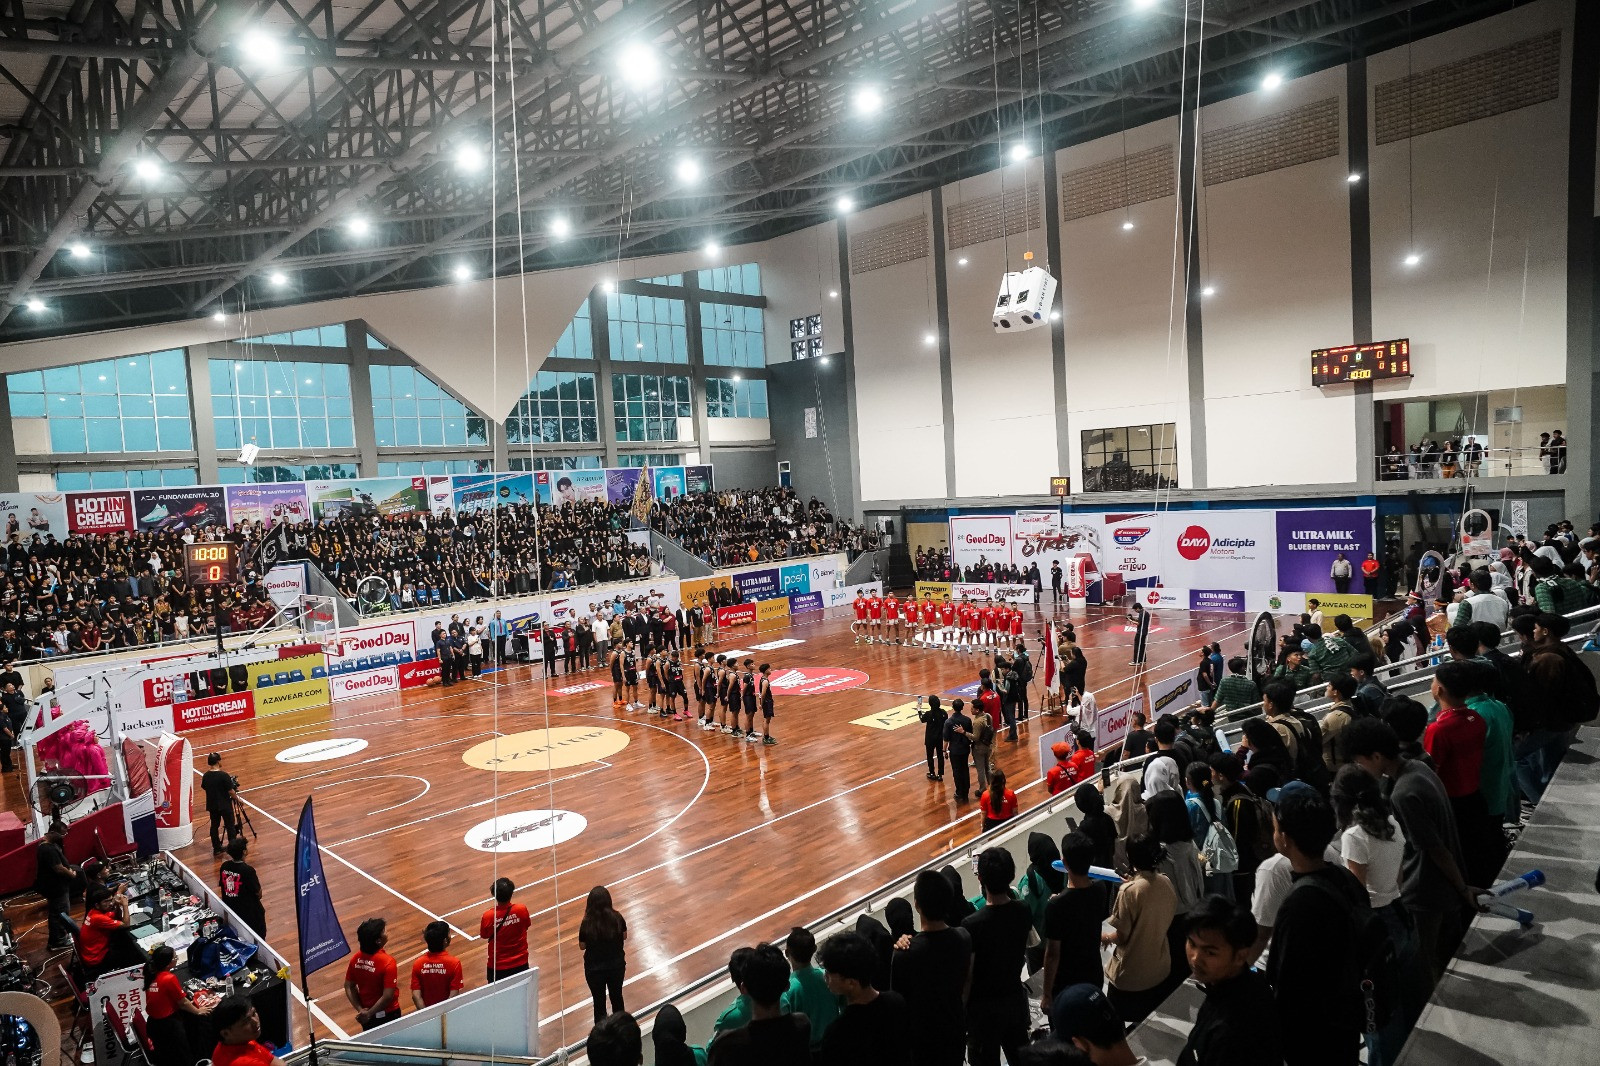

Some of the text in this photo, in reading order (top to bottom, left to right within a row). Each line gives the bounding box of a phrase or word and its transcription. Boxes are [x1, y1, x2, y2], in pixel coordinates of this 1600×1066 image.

[74, 497, 124, 513] HOT IN
[76, 512, 125, 526] CREAM
[966, 534, 987, 544] Good
[988, 534, 1006, 546] Day
[1292, 530, 1354, 540] ULTRA MILK
[1181, 538, 1255, 549] DAYA Adicipta
[1288, 543, 1331, 551] BLUEBERRY
[195, 547, 227, 560] 10:00
[210, 566, 220, 581] 0
[266, 580, 300, 590] Good Day
[742, 578, 758, 587] ULTRA
[976, 588, 988, 597] Day
[728, 611, 754, 620] HONDA
[351, 631, 410, 650] Good Day
[345, 675, 393, 691] Good Day
[262, 688, 322, 705] AZAWEAR.COM
[182, 699, 247, 719] HOT IN CREAM
[121, 718, 164, 732] Jackson
[1108, 714, 1127, 734] Good
[155, 746, 163, 776] CREAM
[129, 988, 142, 1007] HOT
